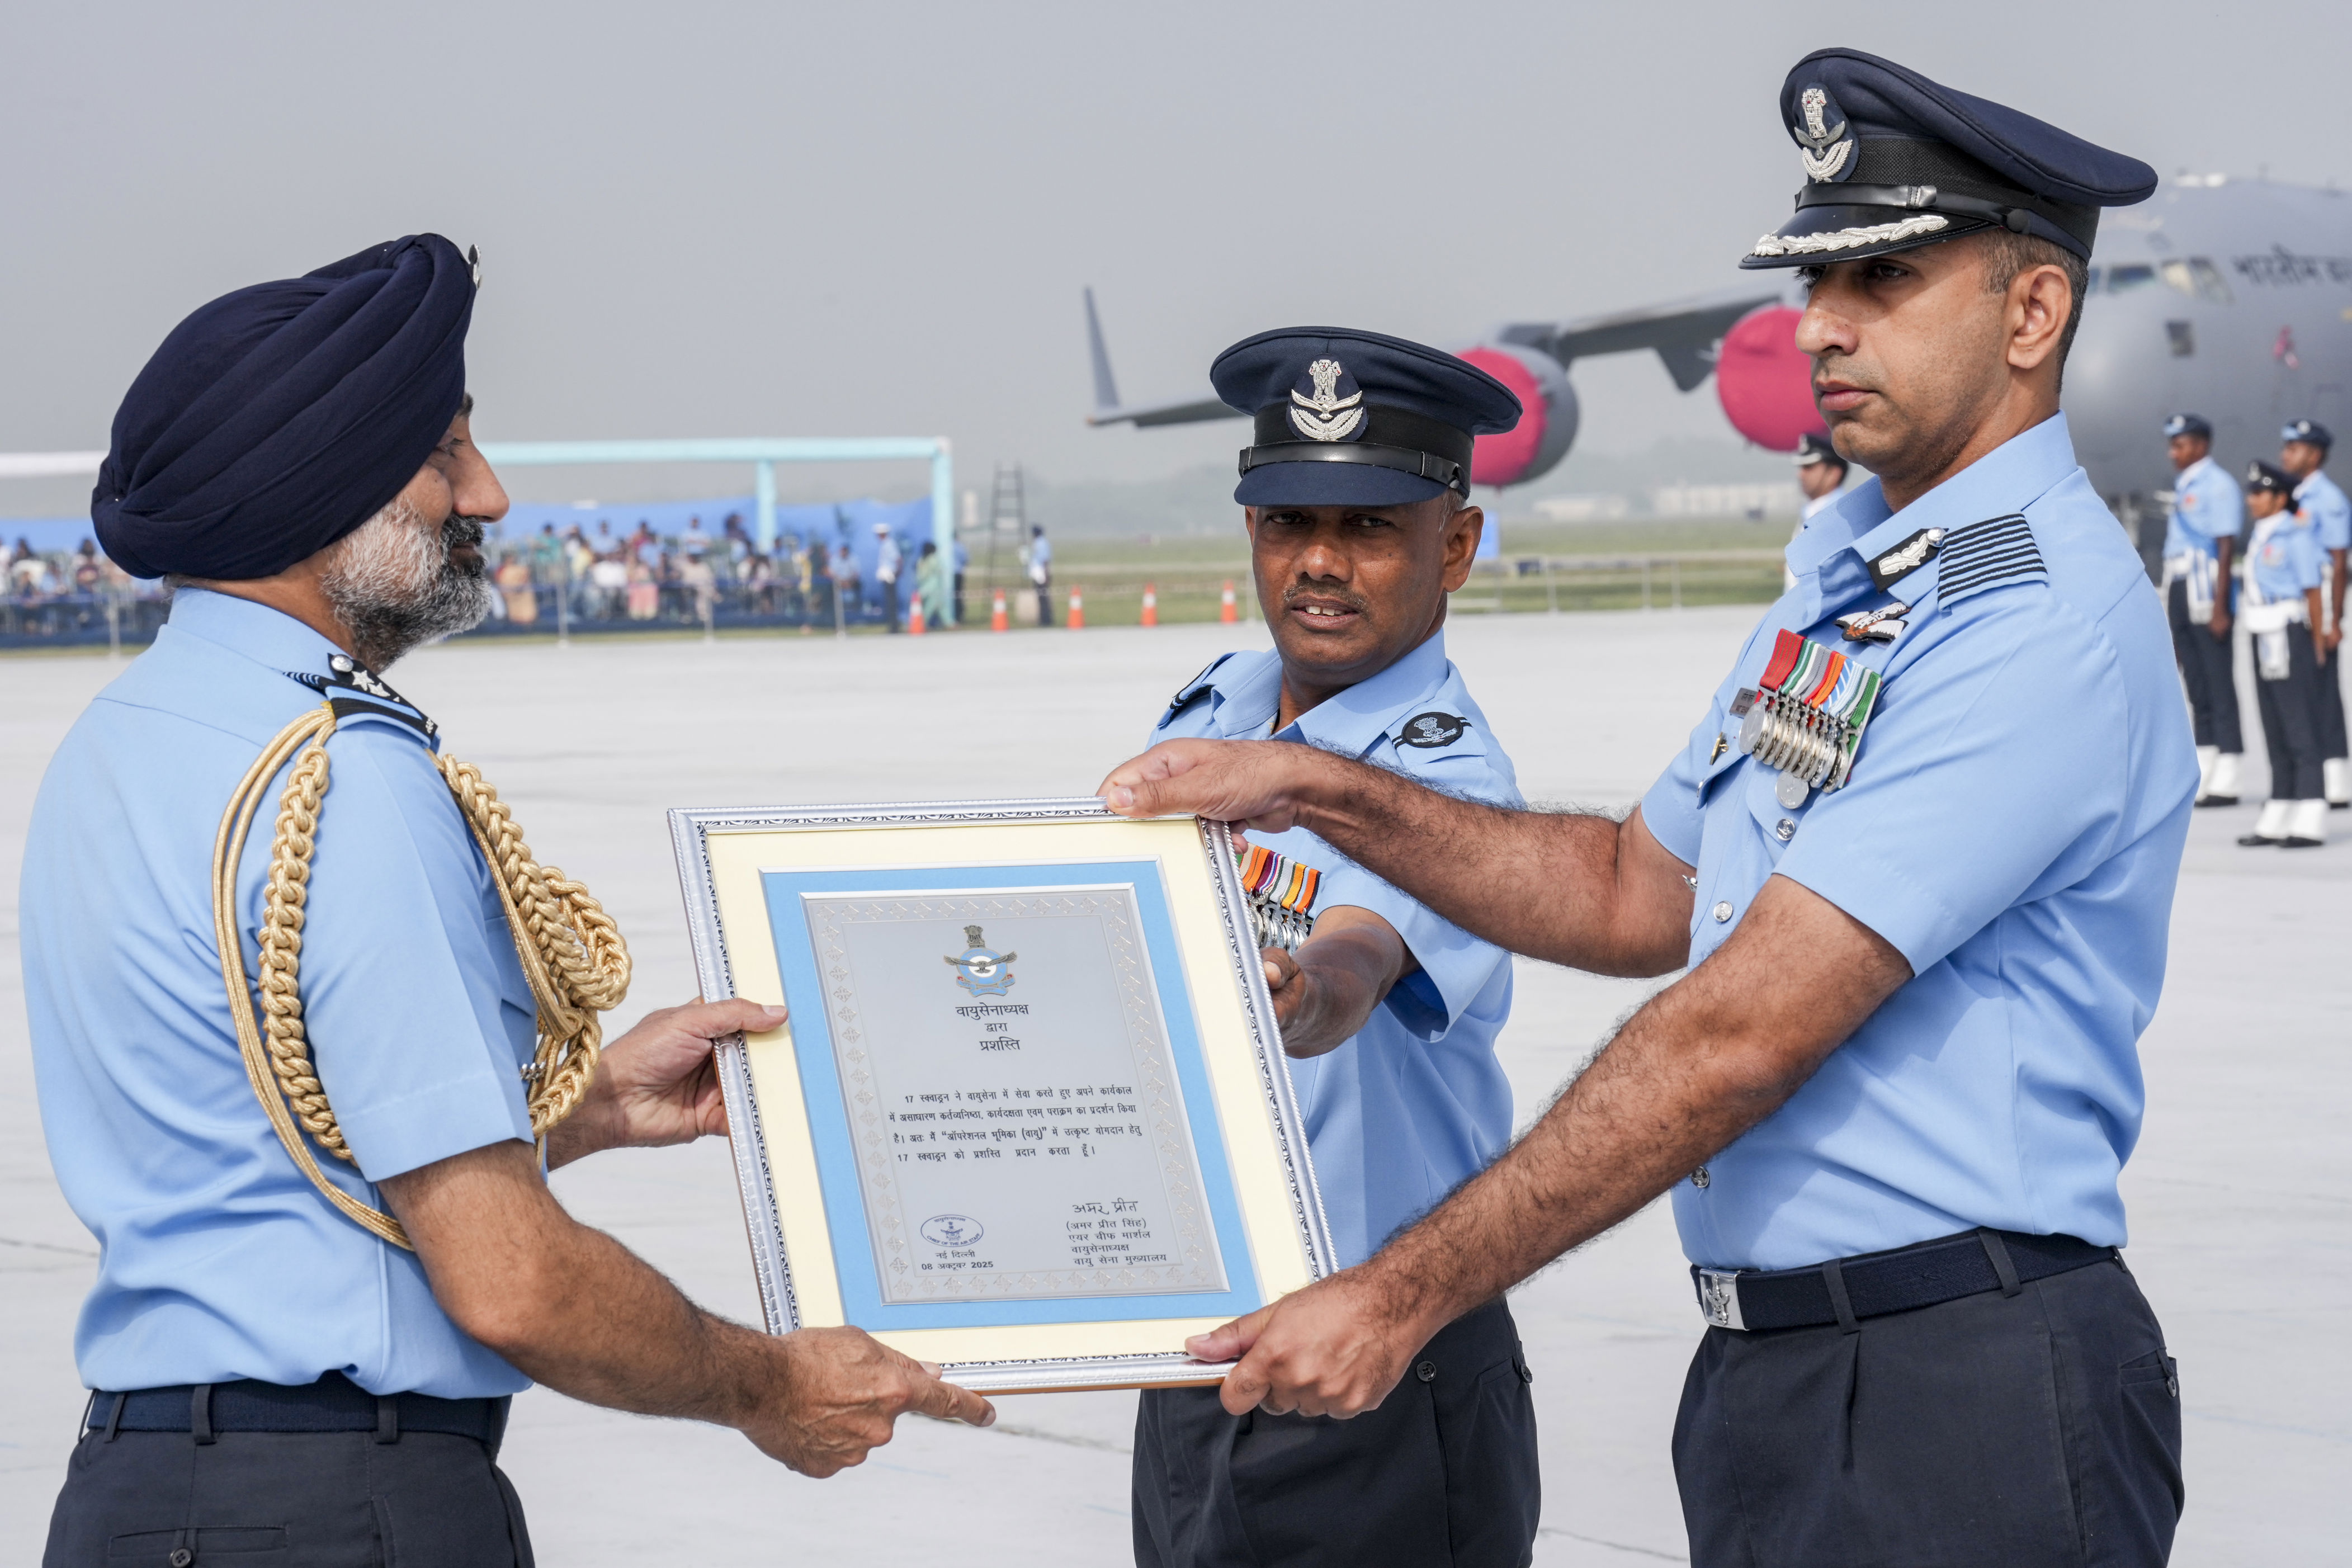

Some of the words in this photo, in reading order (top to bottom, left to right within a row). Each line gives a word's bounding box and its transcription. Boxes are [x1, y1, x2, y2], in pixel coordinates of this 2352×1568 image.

[956, 1002, 1029, 1020] वायुसेनाध्यक्ष
[985, 1023, 1008, 1032] द्वारा
[980, 1037, 1020, 1051] प्रशस्ति
[919, 1094, 949, 1103] स्क्वाड्रन
[955, 1090, 961, 1101] ने
[967, 1089, 996, 1102] वायुसेना
[1014, 1088, 1030, 1098] सेवा
[1035, 1087, 1053, 1097] करते
[1059, 1089, 1071, 1099] हुए
[1076, 1085, 1093, 1096] अपने
[1099, 1085, 1132, 1095] कार्यकाल
[900, 1113, 936, 1121] असाधारण
[986, 1107, 1023, 1118] कार्यदक्षता
[1027, 1109, 1044, 1118] एवम्
[1047, 1107, 1072, 1116] पराक्रम
[1089, 1103, 1114, 1114] प्रदर्शन
[1117, 1103, 1136, 1113] किया
[991, 1128, 1016, 1142] भूमिका
[1064, 1128, 1089, 1138] उत्कृष्ट
[1094, 1125, 1123, 1135] योगदान
[1128, 1123, 1142, 1136] हेतु
[917, 1153, 946, 1161] स्क्वाड्रन
[953, 1149, 965, 1159] को
[973, 1147, 1000, 1159] प्रशस्ति
[1072, 1202, 1109, 1215] अमर
[1111, 1198, 1138, 1212] प्रीत
[1066, 1221, 1092, 1231] (अमर
[1098, 1219, 1116, 1229] प्रीत
[1122, 1217, 1146, 1229] सिंह)
[1095, 1231, 1116, 1240] चीफ
[1121, 1230, 1150, 1239] मार्शल
[935, 1250, 947, 1259] नई
[952, 1249, 975, 1258] दिल्ली
[1071, 1244, 1130, 1255] वायुसेनाध्यक्ष
[1074, 1258, 1094, 1267] वायु
[1098, 1255, 1118, 1264] सेना
[1125, 1254, 1166, 1265] मुख्यालय
